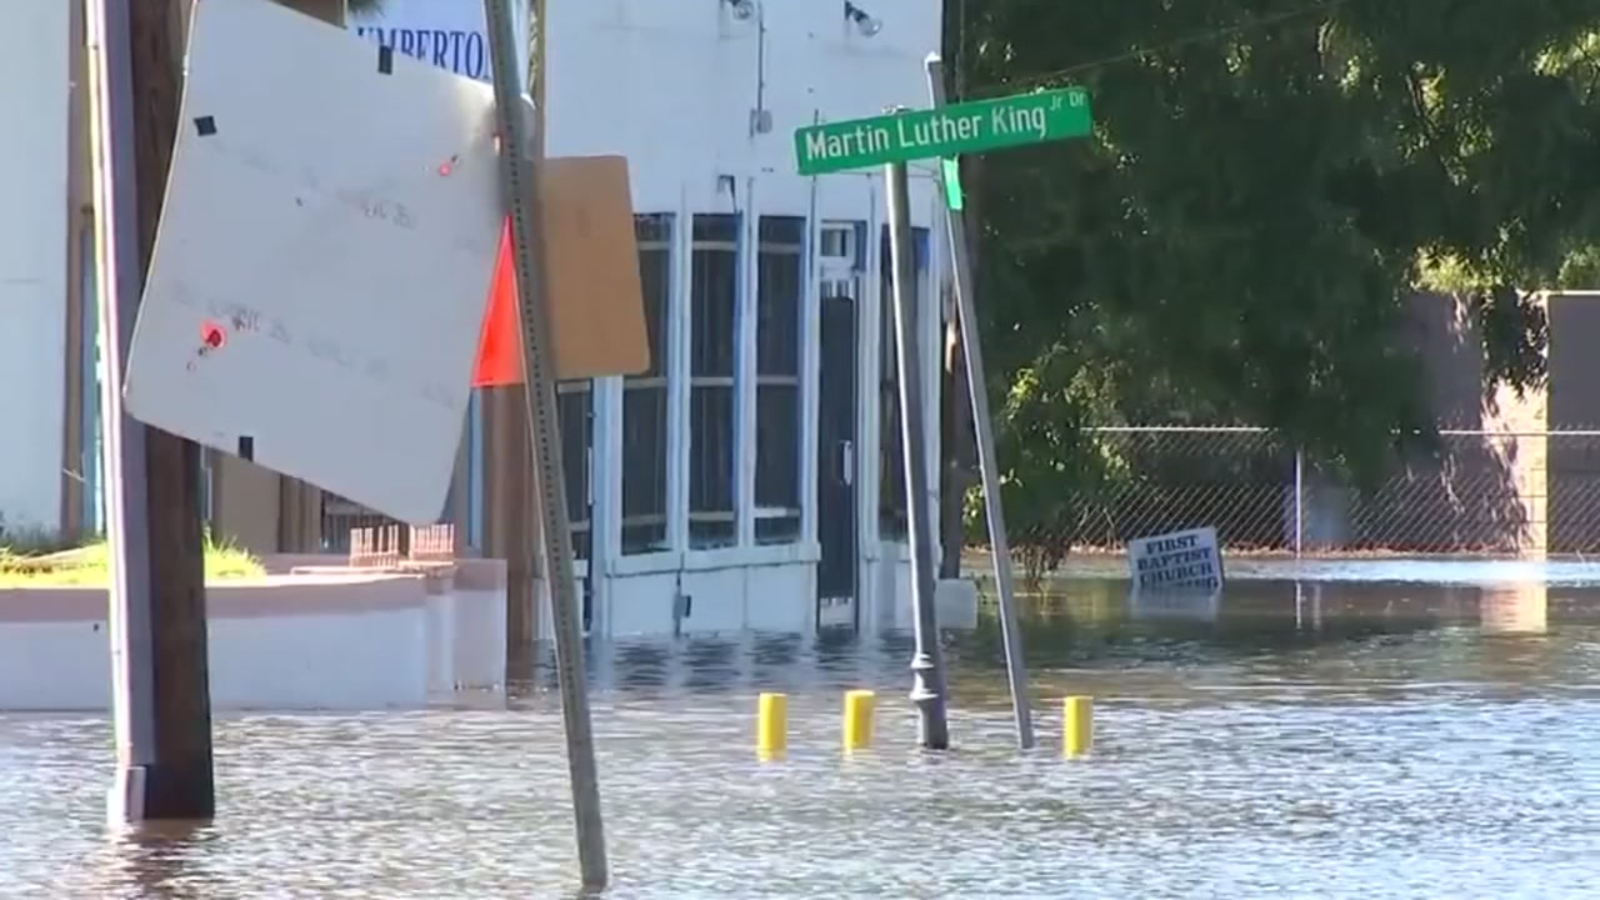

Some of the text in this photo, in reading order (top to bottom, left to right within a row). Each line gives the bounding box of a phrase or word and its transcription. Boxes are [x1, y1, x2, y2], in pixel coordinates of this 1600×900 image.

[804, 90, 1087, 161] Martin Luther King Jr Dr
[1146, 534, 1198, 555] FIRST
[1136, 547, 1212, 571] BAPTIST
[1139, 562, 1213, 588] CHURCH
